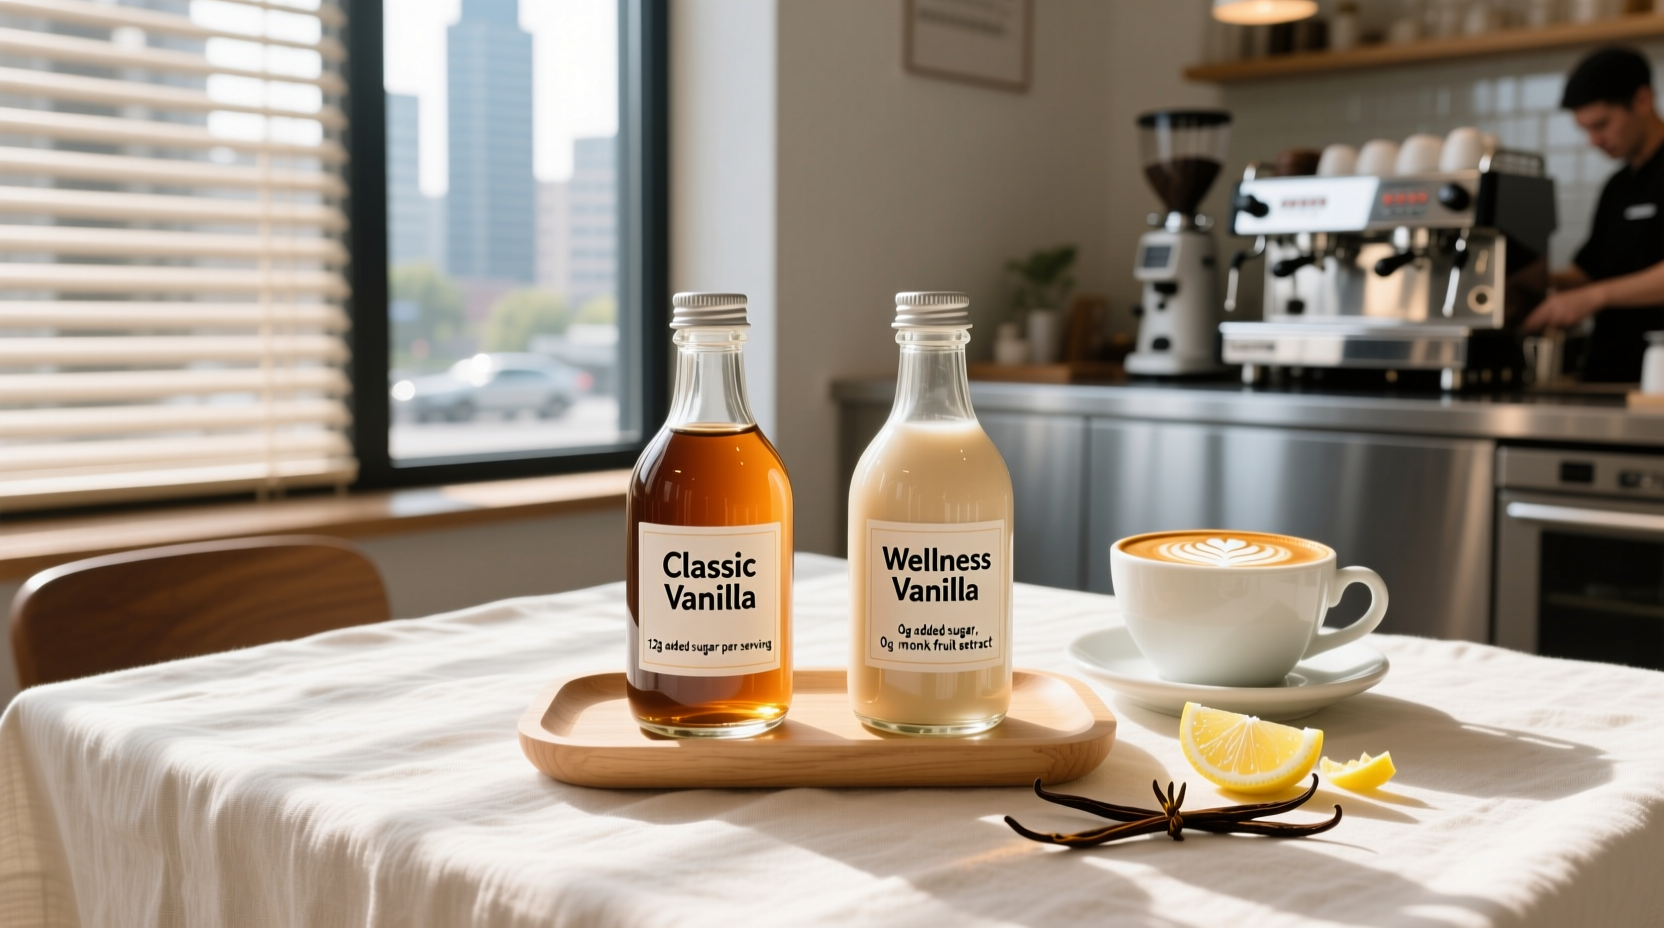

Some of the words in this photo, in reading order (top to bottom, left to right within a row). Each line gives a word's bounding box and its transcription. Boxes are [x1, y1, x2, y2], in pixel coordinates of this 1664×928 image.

[663, 551, 757, 579] Classic
[882, 546, 992, 572] Wellness
[664, 583, 756, 611] Vanilla
[891, 576, 979, 602] Vanilla
[914, 624, 946, 636] added
[948, 625, 979, 639] sugar,
[898, 640, 931, 651] monk
